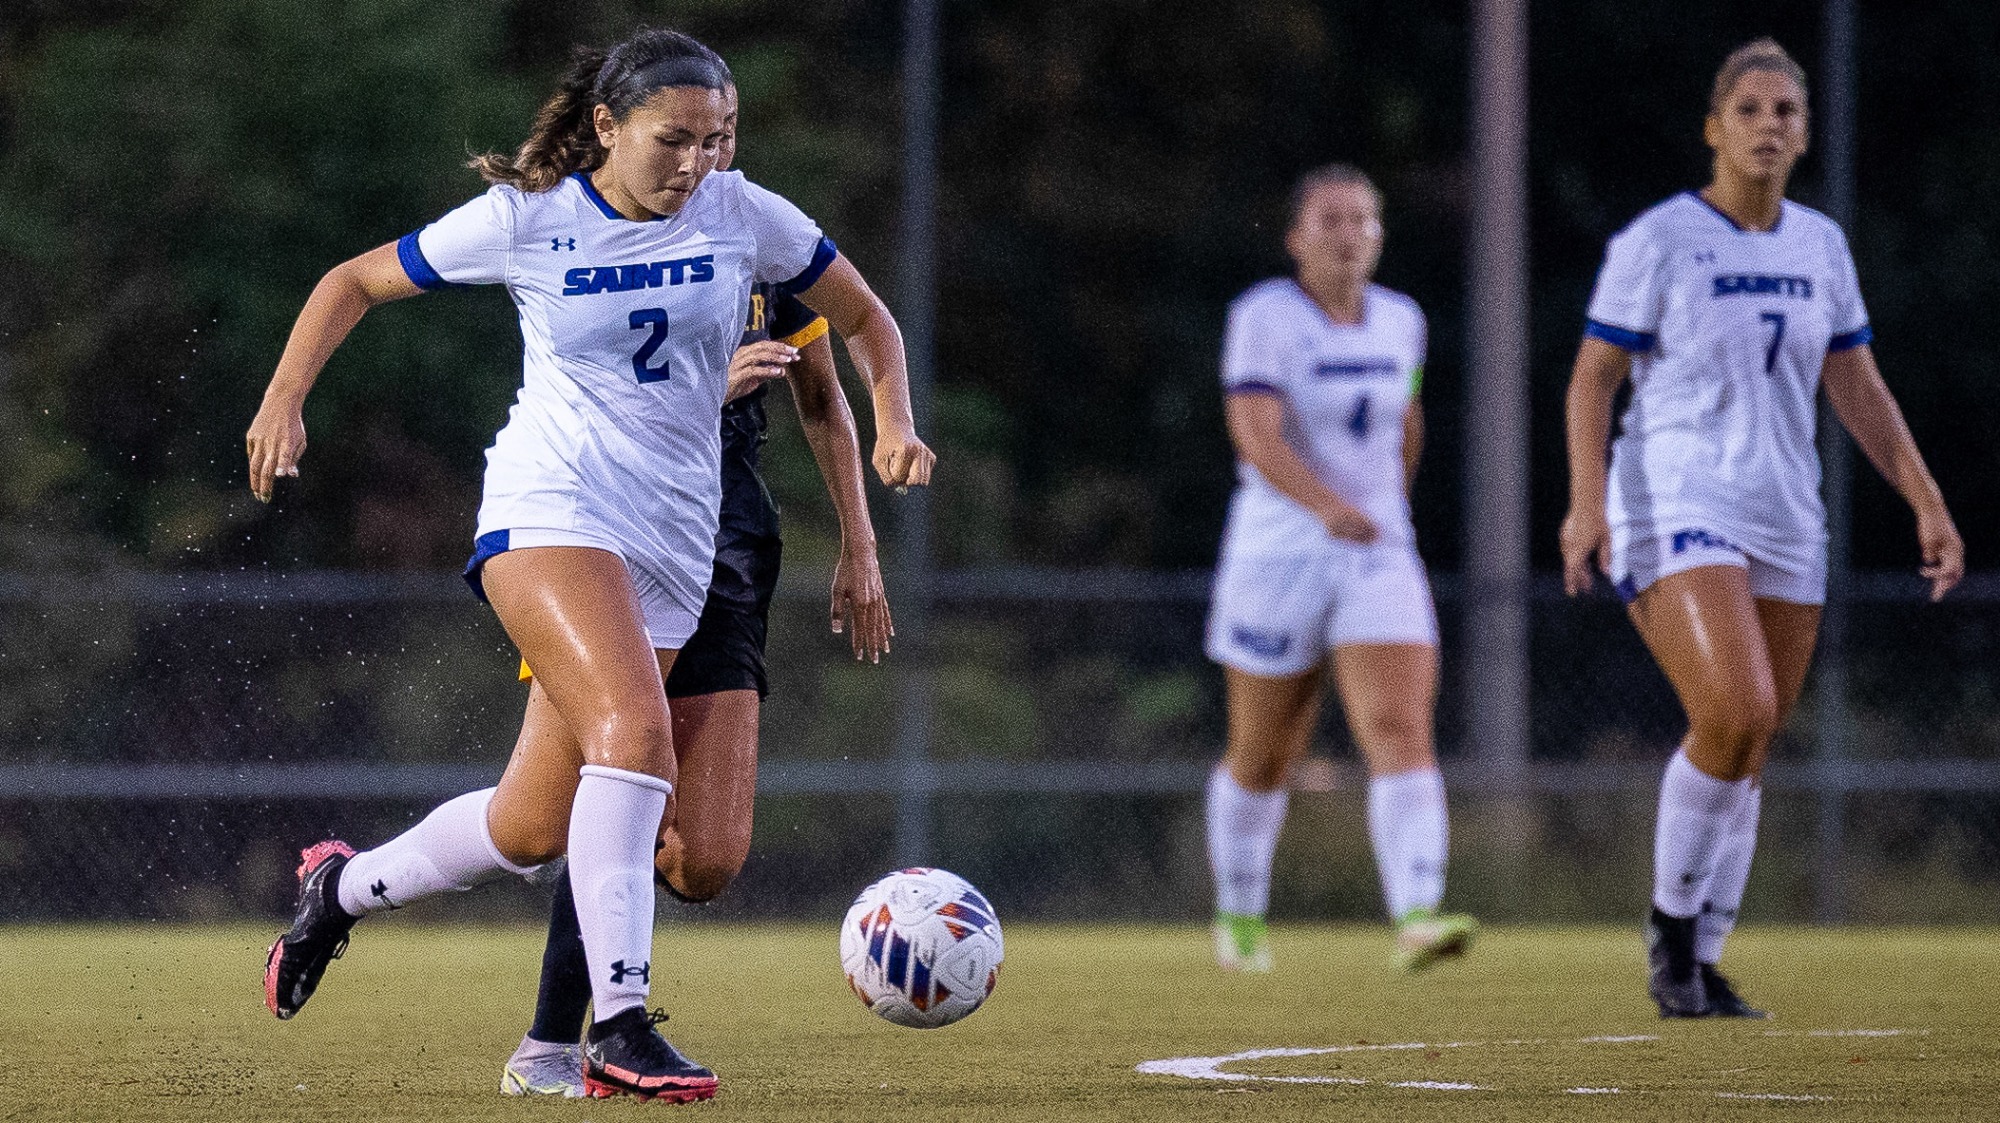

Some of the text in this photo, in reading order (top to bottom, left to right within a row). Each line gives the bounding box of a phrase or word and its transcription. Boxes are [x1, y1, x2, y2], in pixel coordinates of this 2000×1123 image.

[562, 254, 714, 296] SAINTS
[628, 307, 670, 384] 2
[1761, 313, 1786, 374] 7
